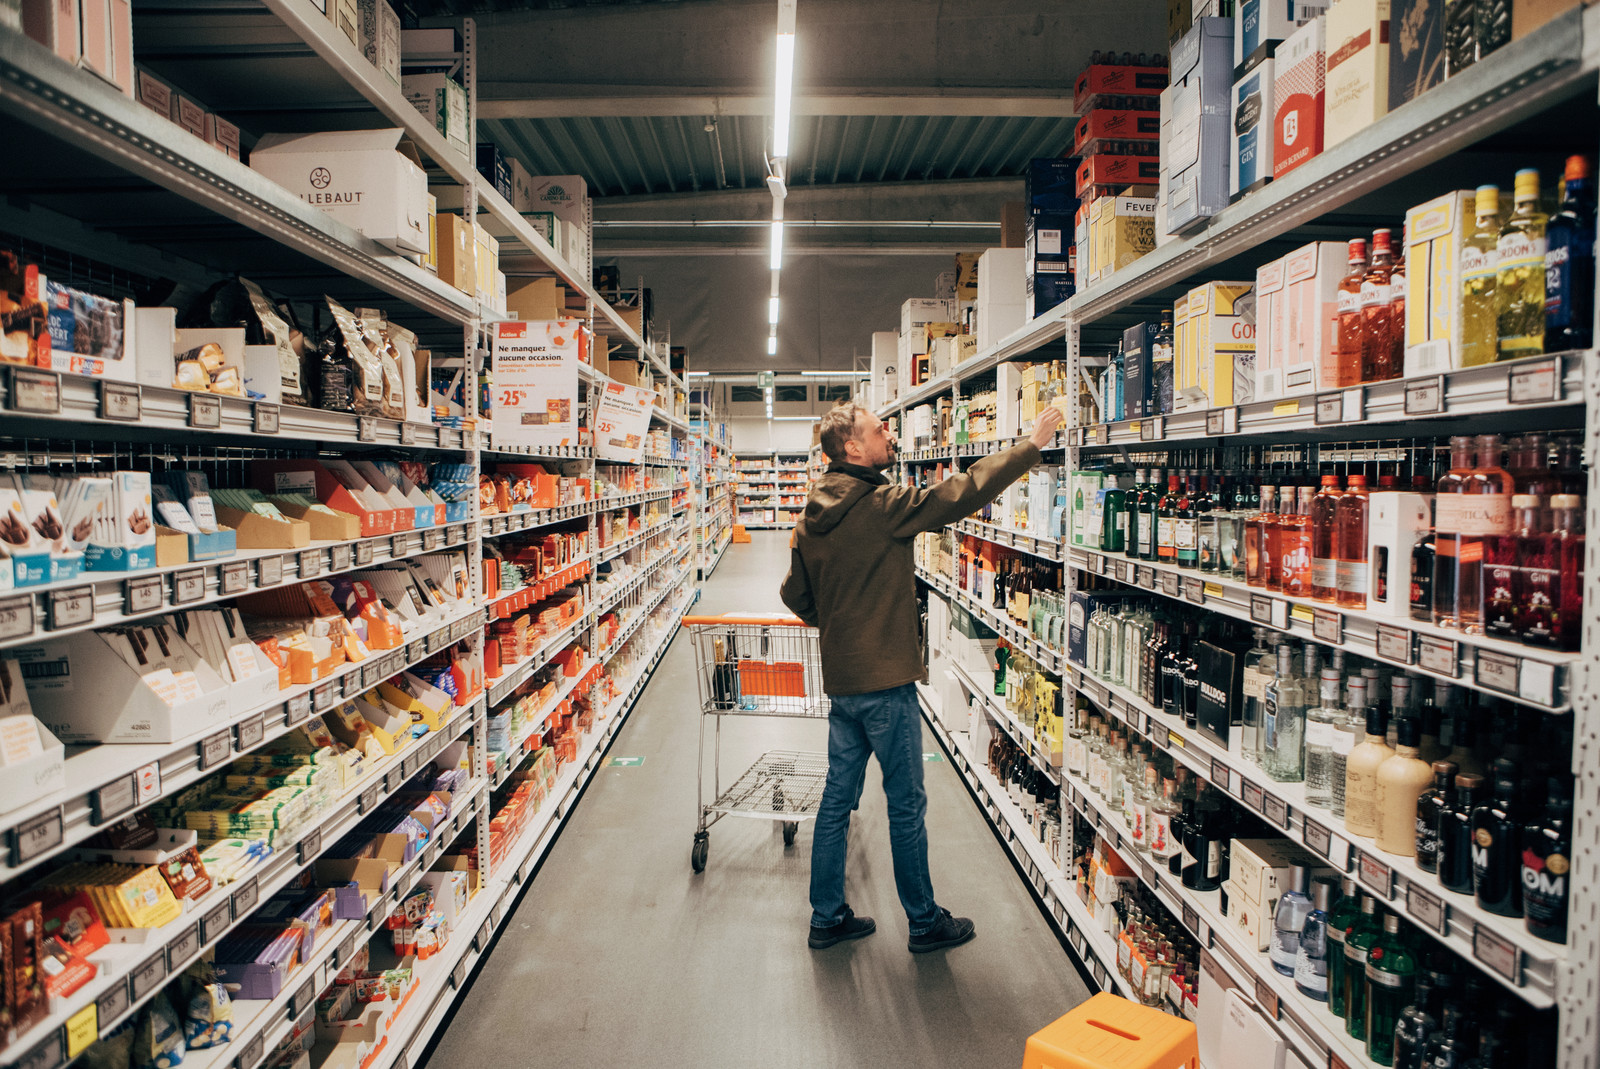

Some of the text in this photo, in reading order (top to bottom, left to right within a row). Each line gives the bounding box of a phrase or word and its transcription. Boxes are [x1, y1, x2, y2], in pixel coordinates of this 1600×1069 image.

[1245, 14, 1256, 32] GIN
[1242, 148, 1254, 164] GIN
[300, 192, 362, 204] LEBAUT
[499, 390, 527, 406] -25%
[65, 602, 80, 612] 1.45
[1201, 682, 1226, 704] BULLDOG
